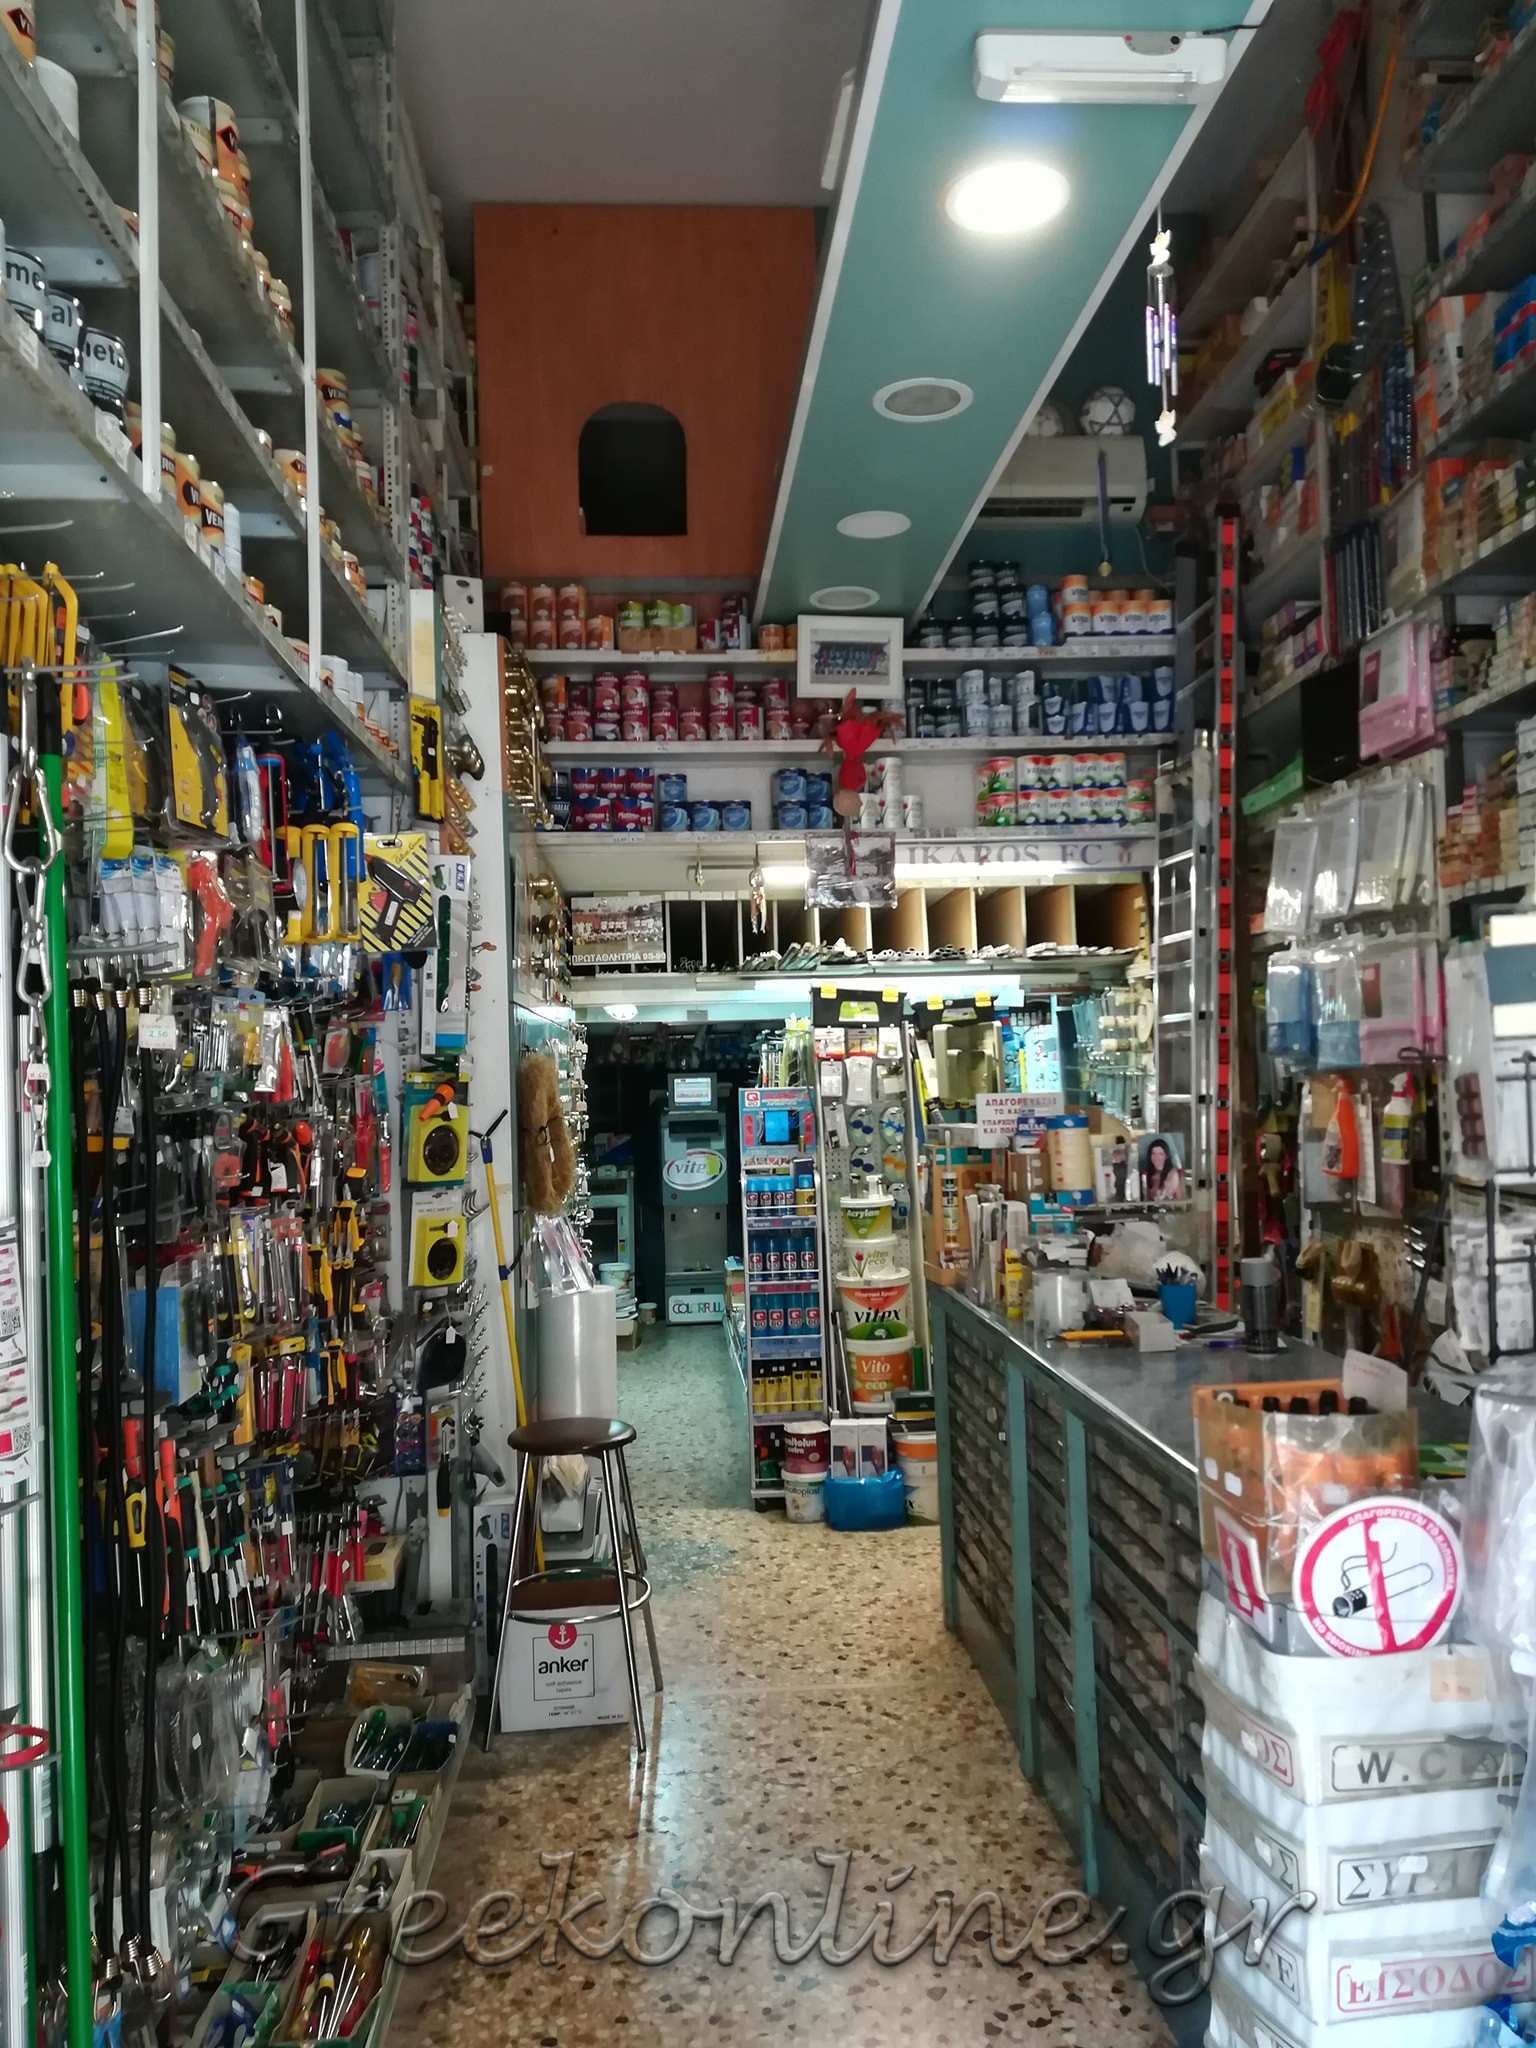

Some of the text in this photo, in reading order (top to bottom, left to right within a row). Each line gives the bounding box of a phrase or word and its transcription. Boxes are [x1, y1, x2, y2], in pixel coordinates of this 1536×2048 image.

[907, 843, 1103, 866] IKAROS FC
[846, 1209, 880, 1218] Acrylan
[854, 1307, 902, 1324] vitex
[861, 1360, 891, 1374] Vito
[865, 1381, 887, 1391] eco
[1347, 1508, 1426, 1528] ΑΠΑΓΟΡΕΥΕΤΑΙ
[1426, 1522, 1440, 1537] ΤΟ
[1312, 1617, 1371, 1657] NO SMOKING
[538, 1656, 589, 1675] anker
